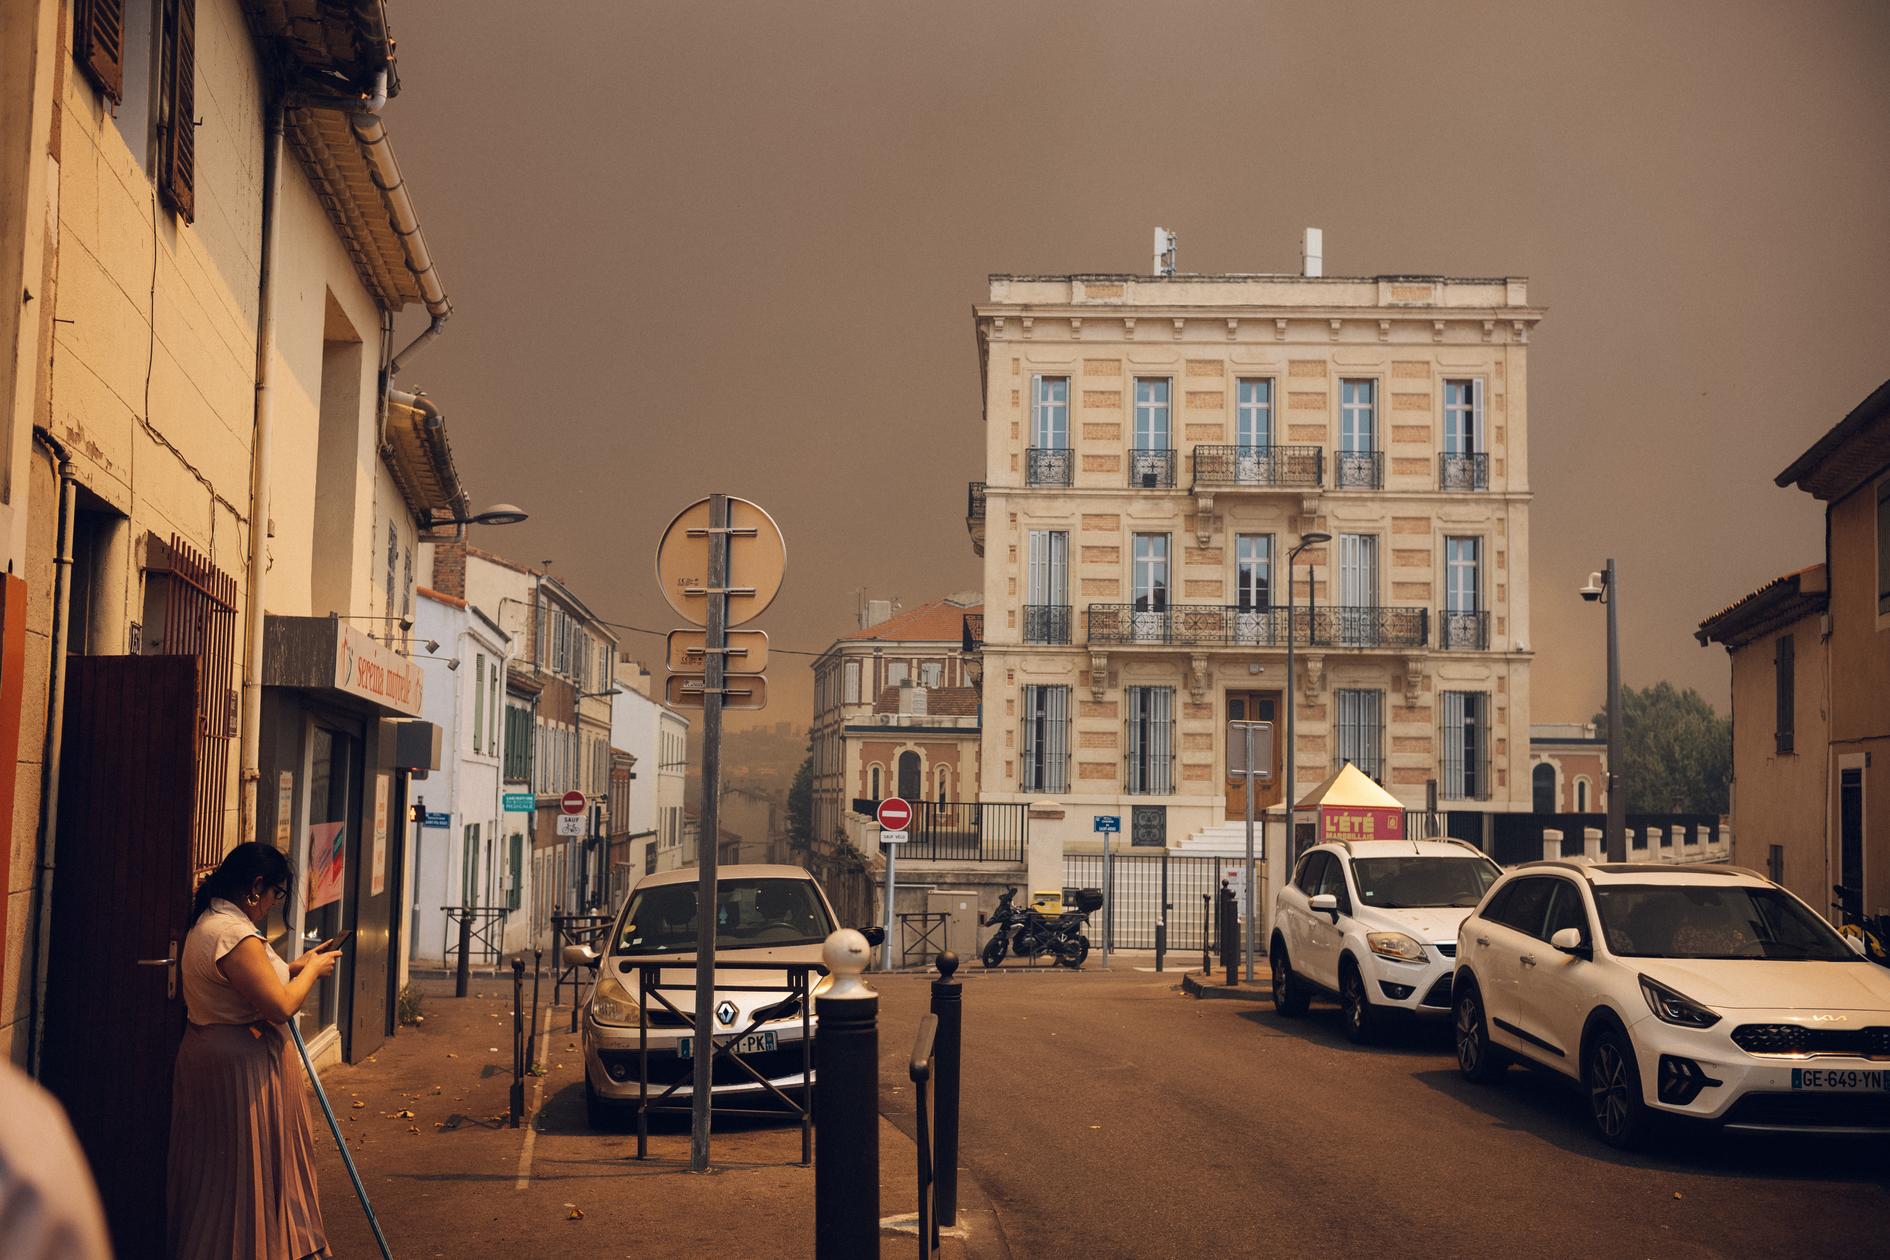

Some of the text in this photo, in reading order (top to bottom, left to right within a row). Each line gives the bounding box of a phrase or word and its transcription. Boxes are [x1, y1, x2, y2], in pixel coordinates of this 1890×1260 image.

[357, 651, 384, 696] sereina
[1325, 812, 1375, 832] L'ÉTÉ
[1803, 1070, 1881, 1089] GE-649-YN
